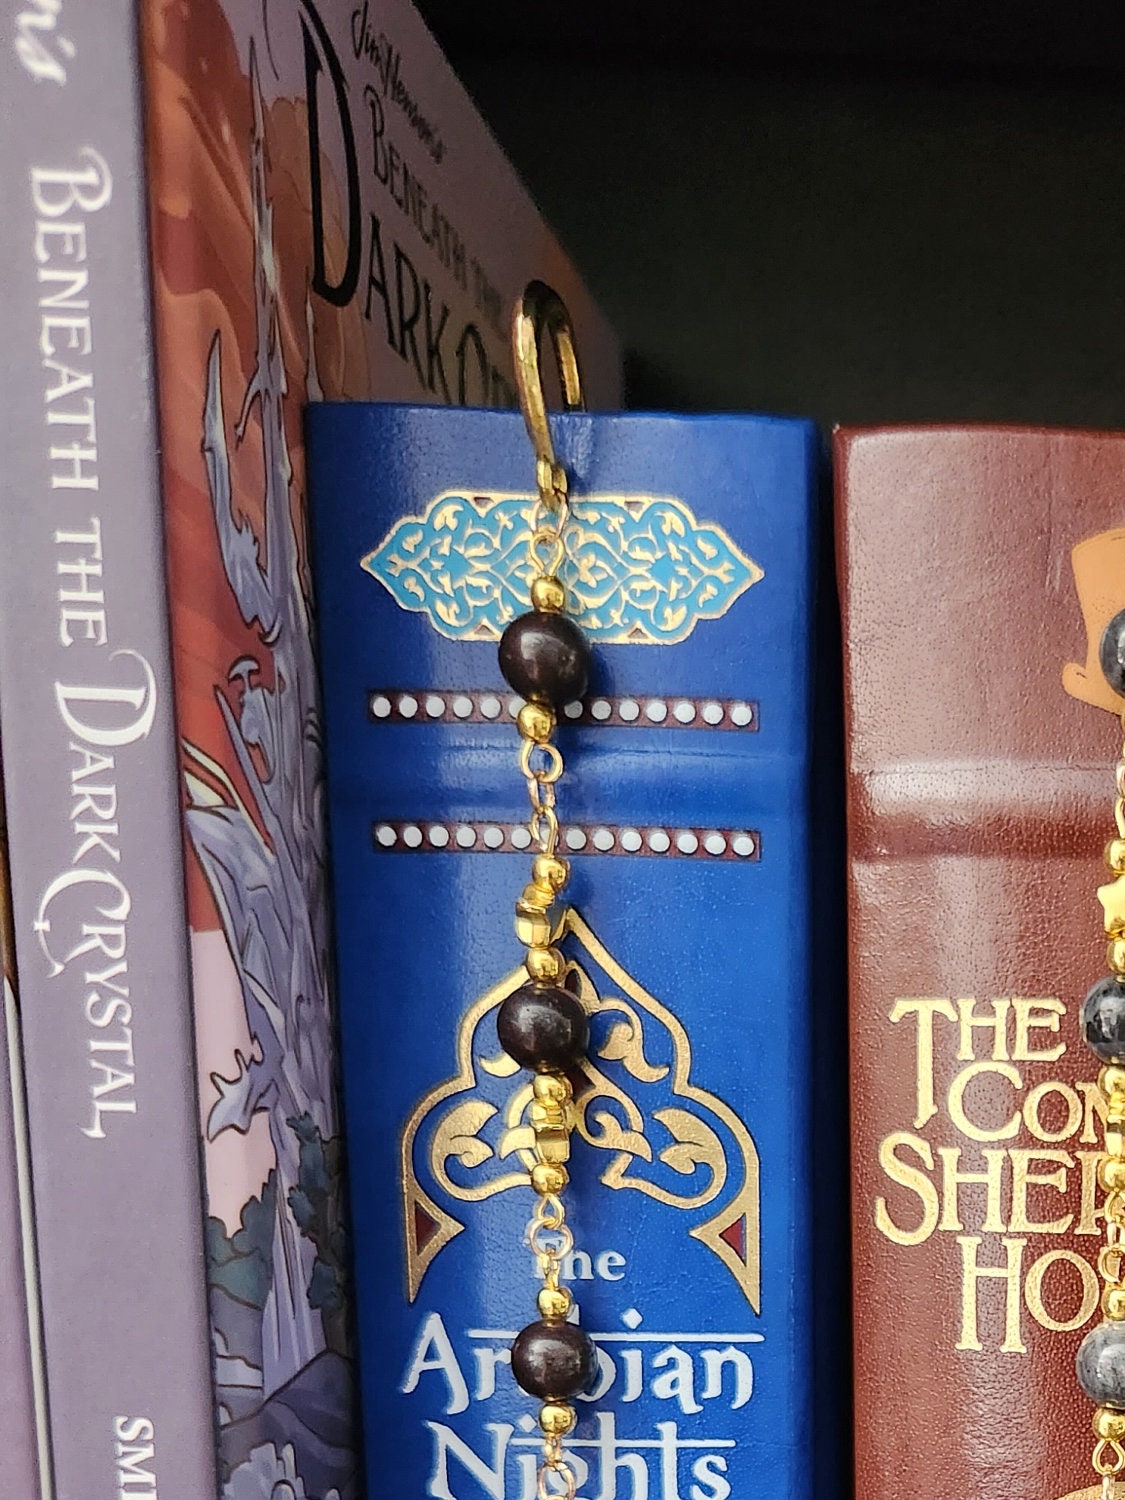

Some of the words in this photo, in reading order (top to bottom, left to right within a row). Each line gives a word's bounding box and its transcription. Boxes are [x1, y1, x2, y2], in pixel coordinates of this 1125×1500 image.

[31, 146, 113, 491] BENEATH
[54, 517, 110, 648] THE
[54, 649, 157, 864] DARK
[32, 867, 139, 1141] CRYSTAL
[889, 997, 1068, 1130] THE
